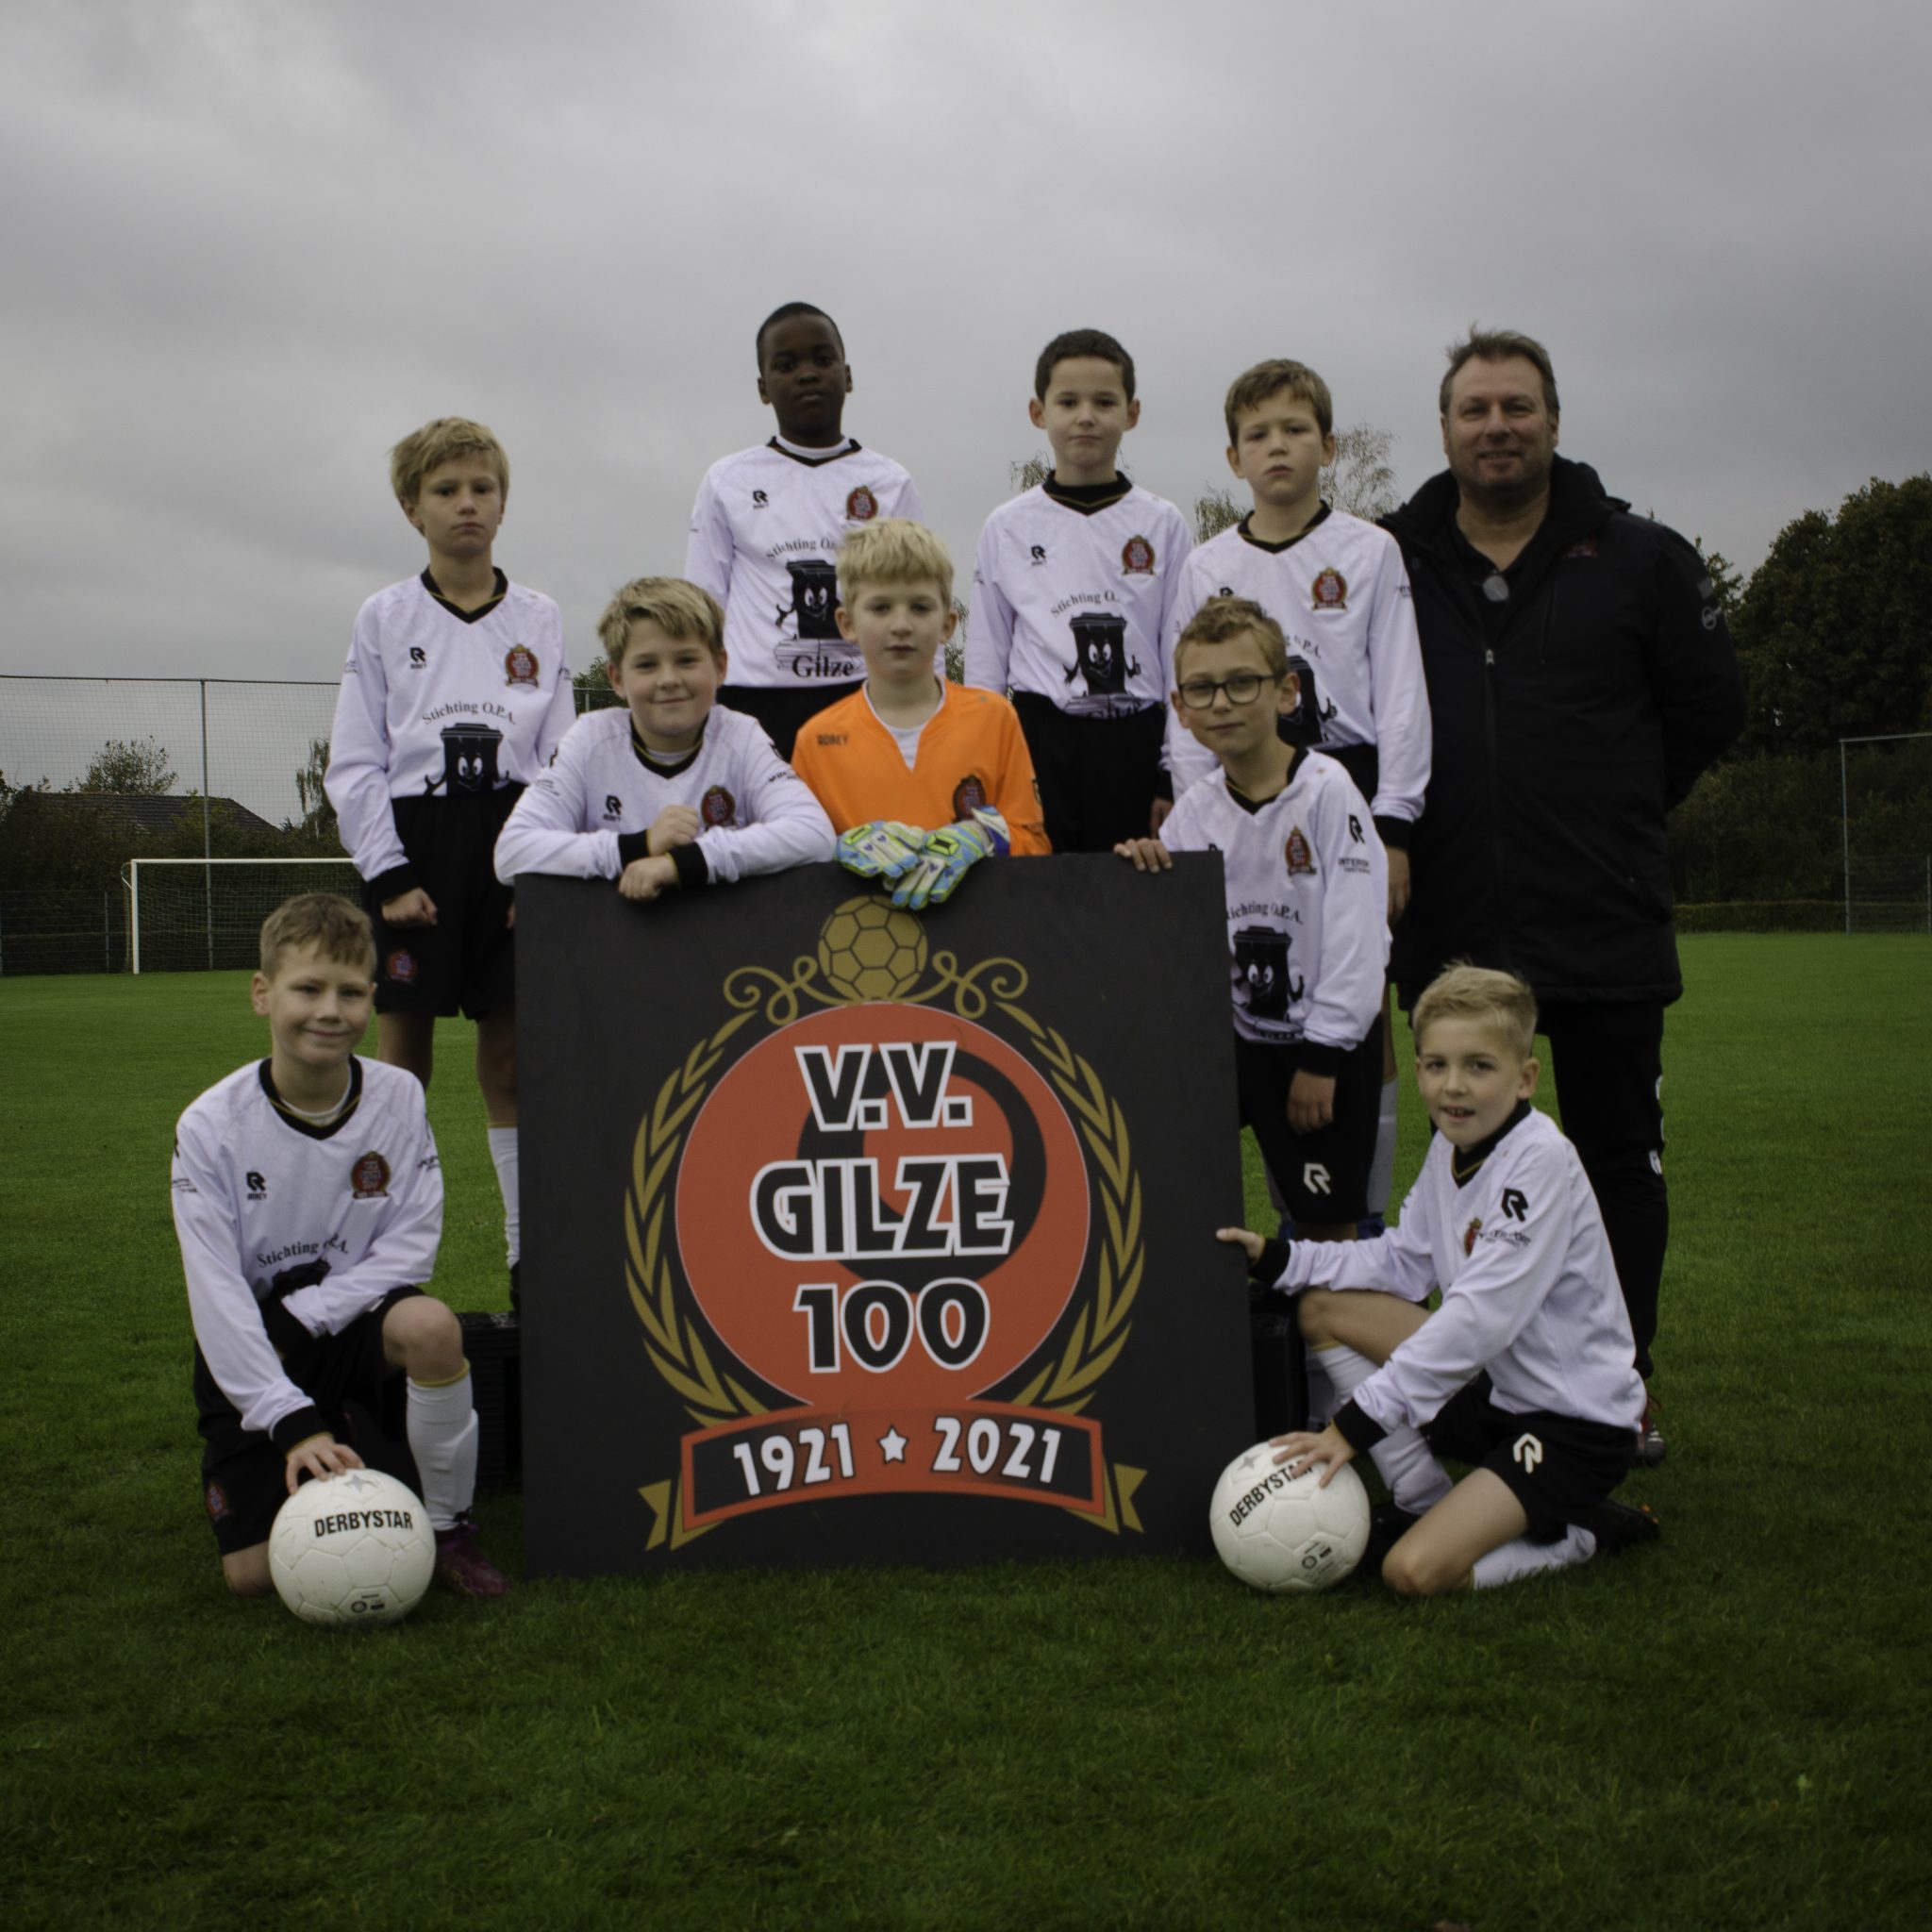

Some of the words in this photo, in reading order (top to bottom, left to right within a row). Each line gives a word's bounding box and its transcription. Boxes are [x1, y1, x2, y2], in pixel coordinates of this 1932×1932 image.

[765, 539, 817, 562] Stichting
[1050, 591, 1102, 618] Stichting
[792, 655, 854, 678] Gilze
[422, 701, 479, 724] Stichting
[1226, 902, 1269, 921] tichting
[794, 1041, 973, 1132] V.V.
[749, 1153, 1014, 1261] GILZE
[257, 1241, 319, 1268] Stichting
[792, 1276, 991, 1374] 100
[732, 1423, 855, 1495] 1921
[932, 1417, 1062, 1483] 2021
[314, 1510, 413, 1538] DERBYSTAR
